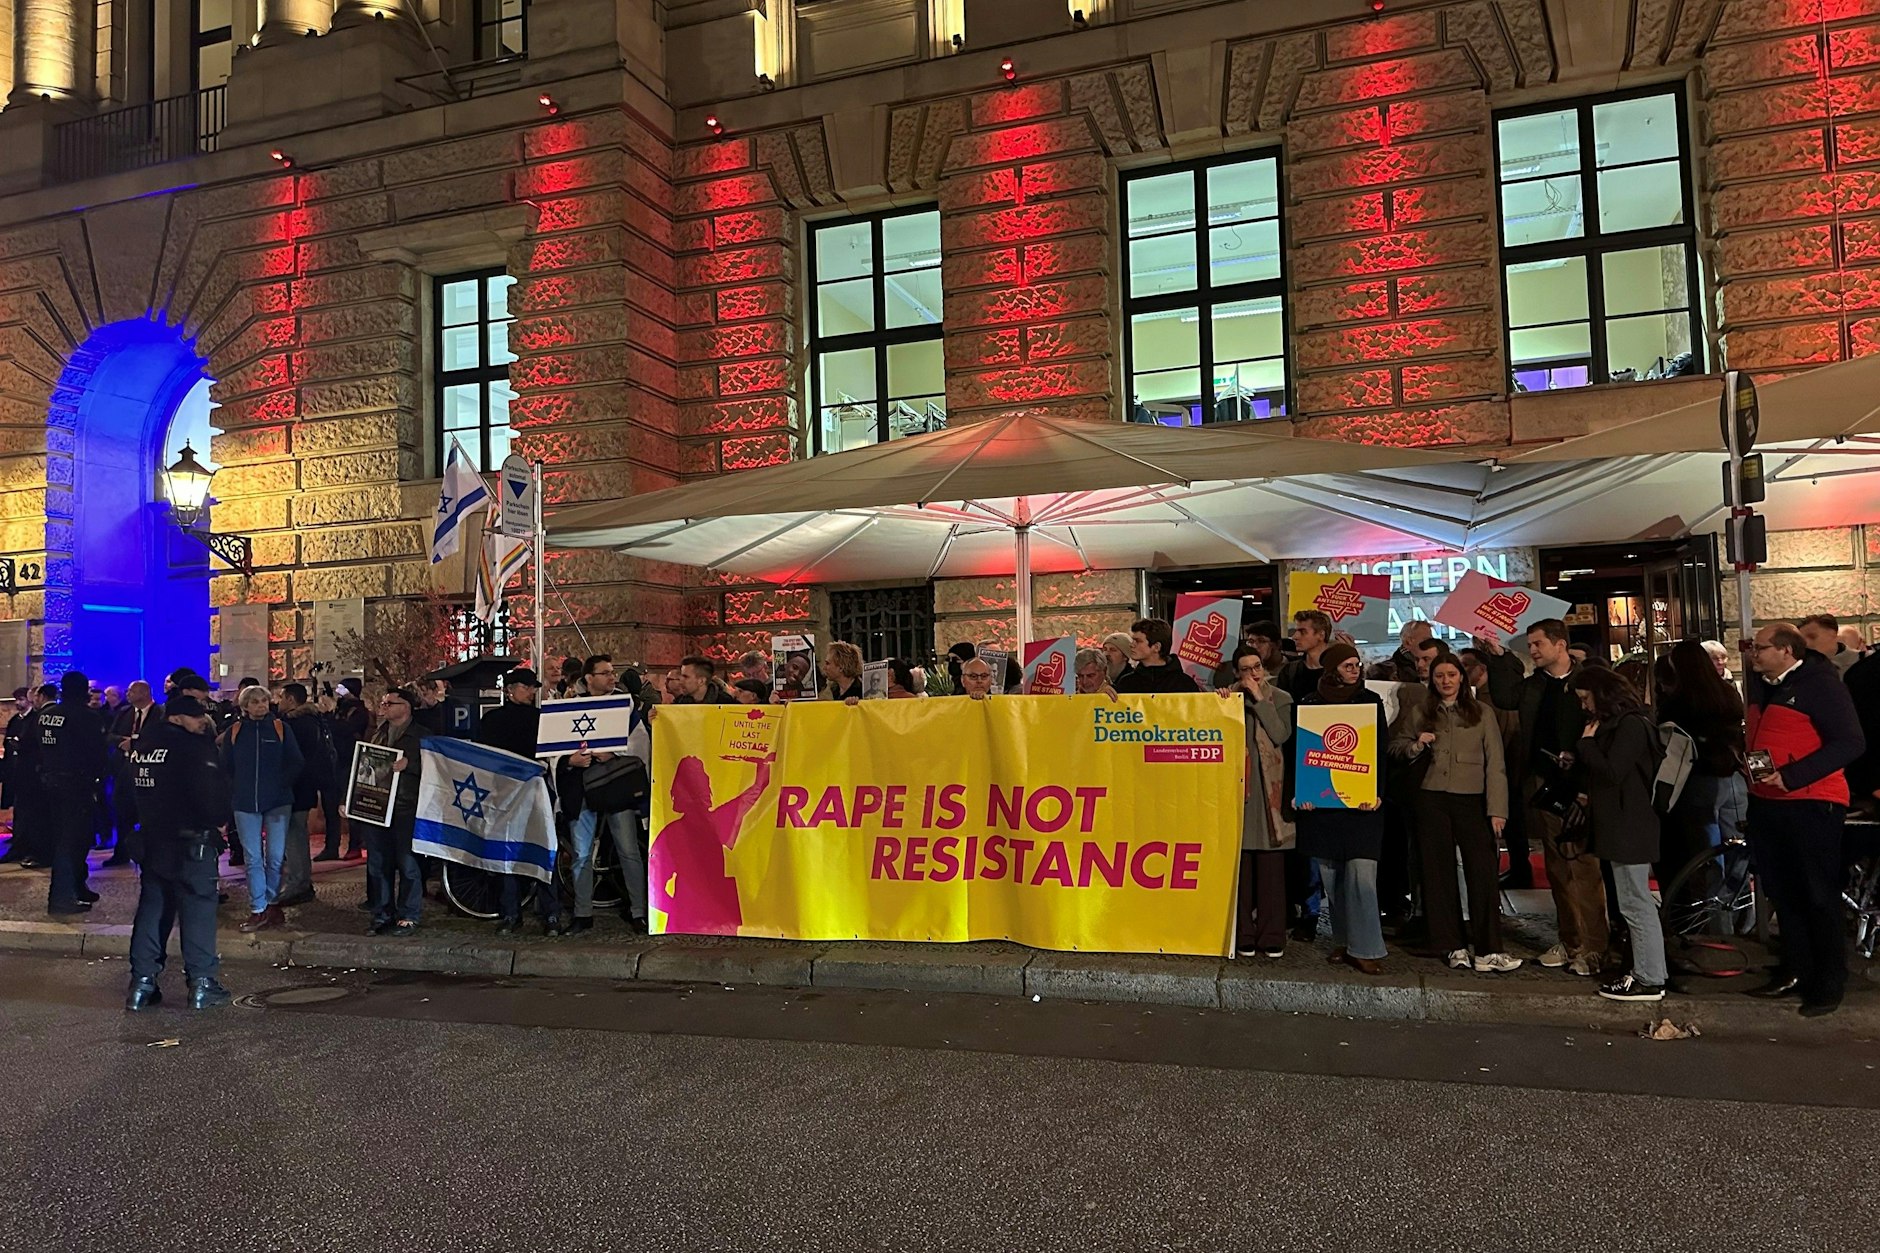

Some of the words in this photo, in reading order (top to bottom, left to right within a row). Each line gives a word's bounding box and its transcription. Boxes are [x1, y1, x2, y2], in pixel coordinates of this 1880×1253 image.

[20, 563, 41, 580] 42
[1317, 554, 1507, 595] TERN
[1316, 597, 1363, 608] ANTISEMITISM
[1476, 608, 1494, 620] WITH
[1492, 618, 1514, 632] ISRAEL
[1481, 603, 1491, 613] WE
[1491, 609, 1513, 624] STAND
[1182, 641, 1194, 651] WE
[1194, 645, 1219, 658] STAND
[1180, 650, 1199, 661] WITH
[1199, 655, 1219, 668] ISRA
[38, 714, 65, 727] POLIZEI
[454, 707, 469, 727] P
[1094, 706, 1144, 723] Freie
[734, 720, 755, 729] UNTIL
[757, 722, 772, 730] THE
[1094, 725, 1223, 742] Demokraten
[742, 731, 760, 739] LAST
[729, 740, 770, 751] HOSTAGE
[1190, 747, 1221, 760] FDP
[130, 748, 168, 763] POLIZEI
[1321, 753, 1352, 762] MONEY
[139, 767, 150, 777] BE
[1308, 758, 1320, 766] TO
[1320, 761, 1368, 772] TERRORISTS
[776, 785, 907, 829] RAPE
[921, 784, 968, 830] IS
[986, 783, 1108, 833] NOT
[870, 835, 1203, 890] RESISTANCE
